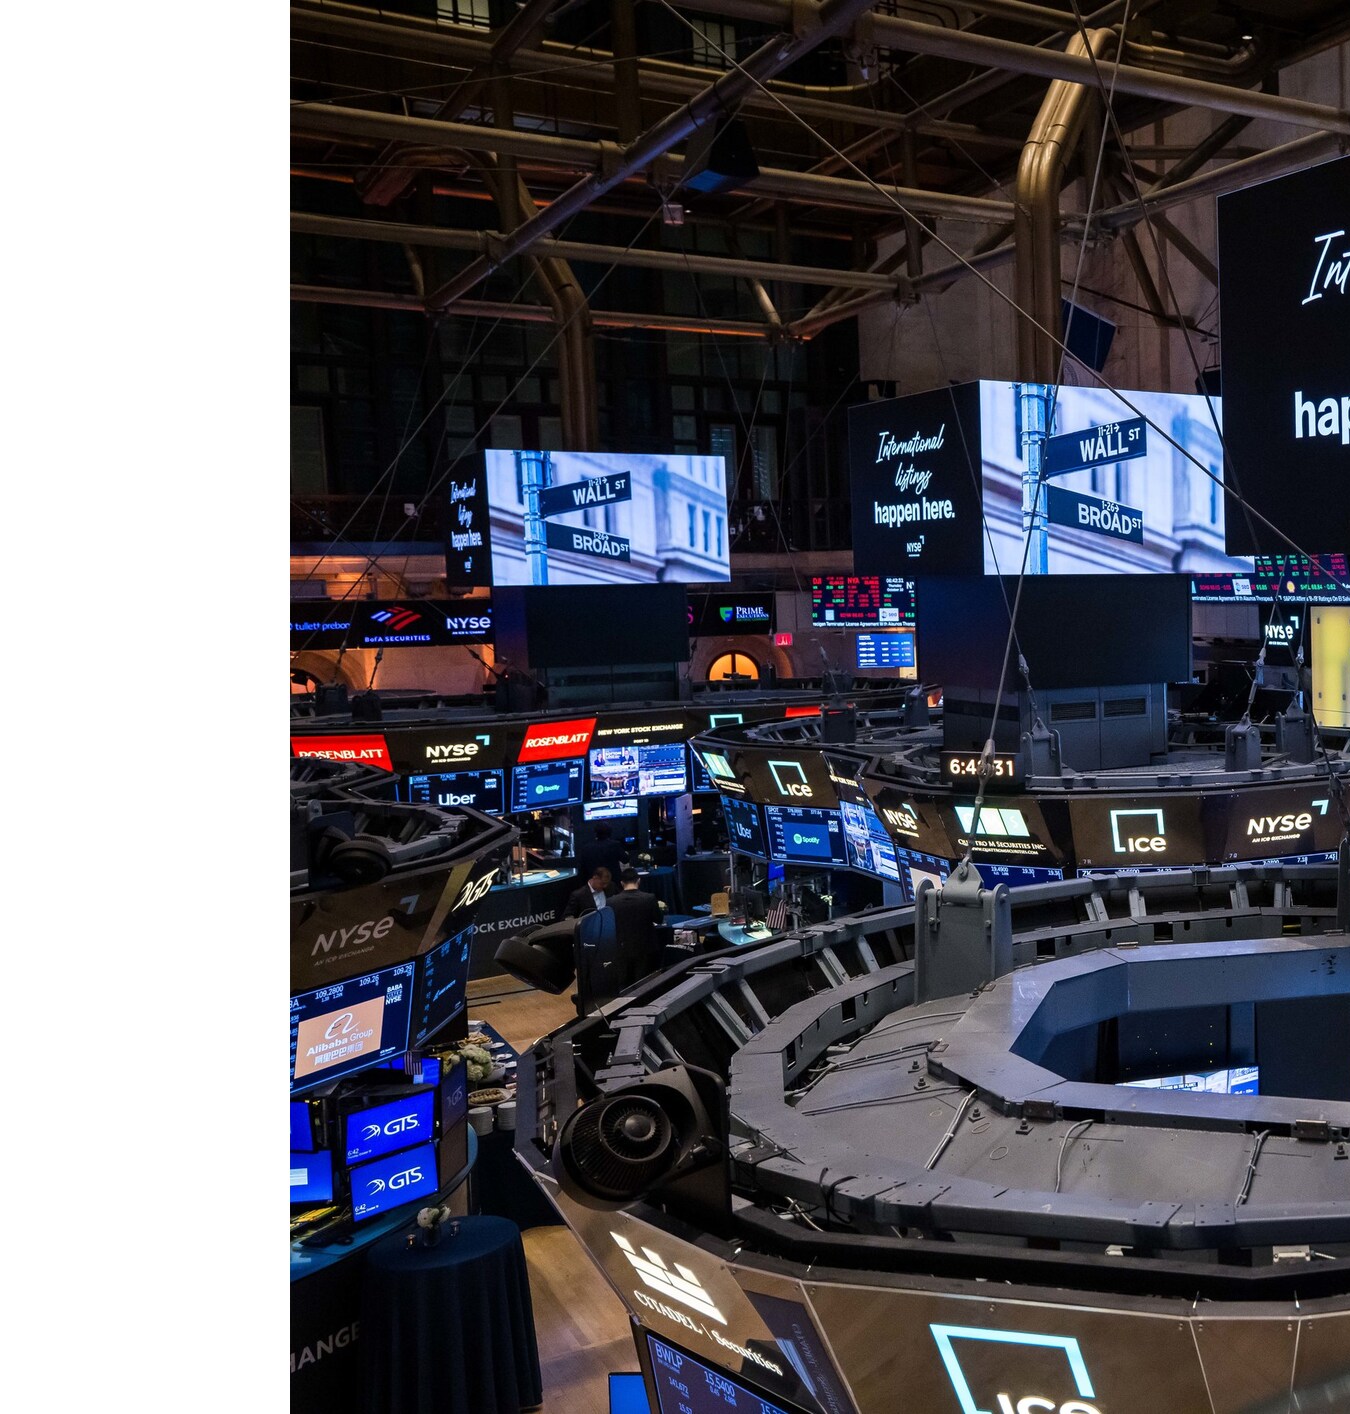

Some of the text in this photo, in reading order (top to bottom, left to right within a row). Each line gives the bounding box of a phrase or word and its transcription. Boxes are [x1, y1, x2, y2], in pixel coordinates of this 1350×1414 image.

[1097, 424, 1113, 437] 11-21
[875, 423, 945, 463] International
[1079, 427, 1141, 463] WALL ST
[894, 462, 933, 495] listings
[572, 479, 626, 506] WALL ST
[874, 496, 956, 528] happen here.
[1077, 503, 1142, 535] BROAD ST
[572, 533, 629, 556] BROAD ST
[736, 606, 764, 615] PRIME
[385, 634, 431, 643] SECURITIES
[651, 723, 684, 732] EXCHANGE
[525, 732, 590, 749] ROSENBLATT
[438, 792, 476, 806] Uber
[736, 821, 752, 840] Uber
[802, 836, 820, 845] Spotify
[996, 840, 1031, 850] SECURITIES
[498, 909, 556, 931] EXCHANGE
[315, 985, 344, 1000] 109.2800
[385, 994, 402, 1006] NYSE
[306, 1028, 374, 1057] Alibaba Group
[633, 1289, 784, 1377] CITADEL Securities
[654, 1342, 683, 1369] BWLP
